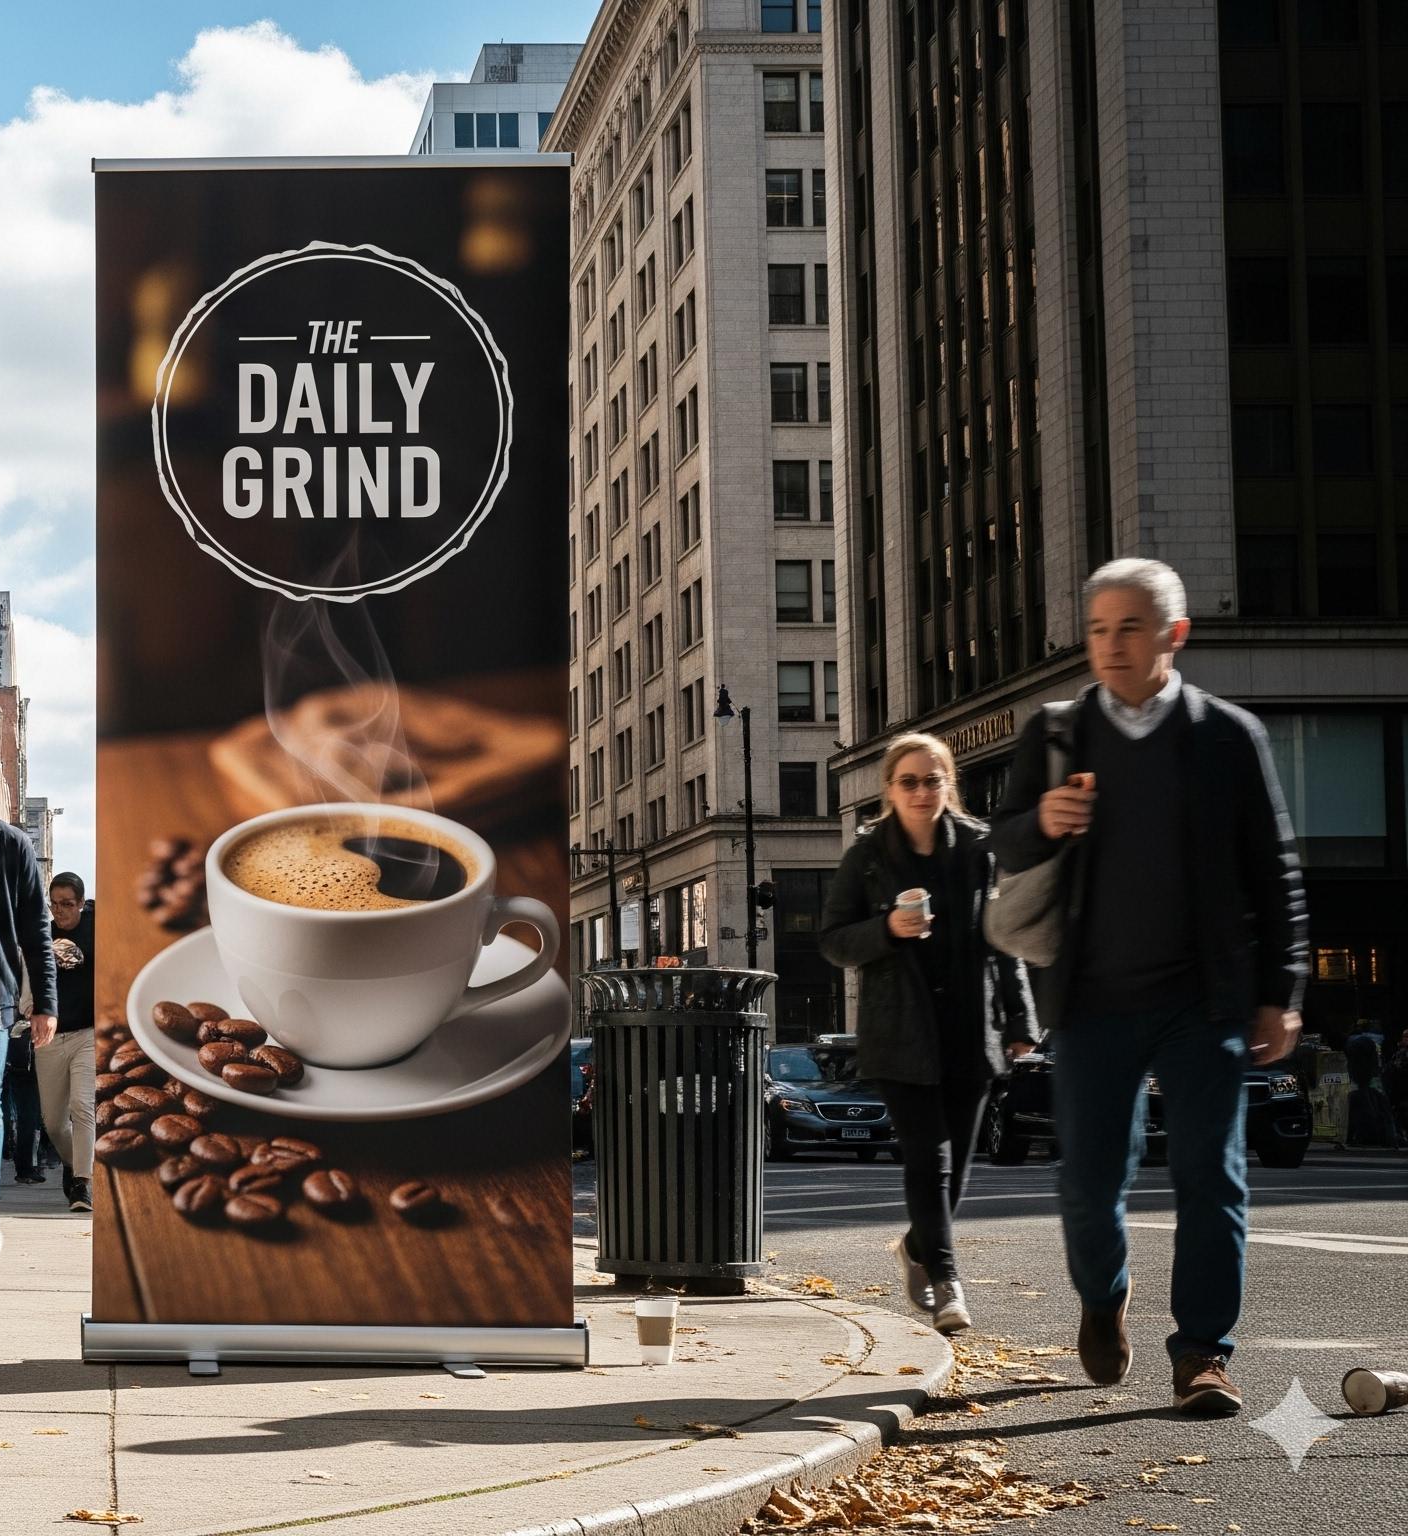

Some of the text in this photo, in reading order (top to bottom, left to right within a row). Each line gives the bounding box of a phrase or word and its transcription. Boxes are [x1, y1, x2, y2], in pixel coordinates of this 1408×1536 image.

[308, 320, 363, 355] THE
[238, 362, 436, 434] DAILY
[222, 445, 441, 519] GRIND
